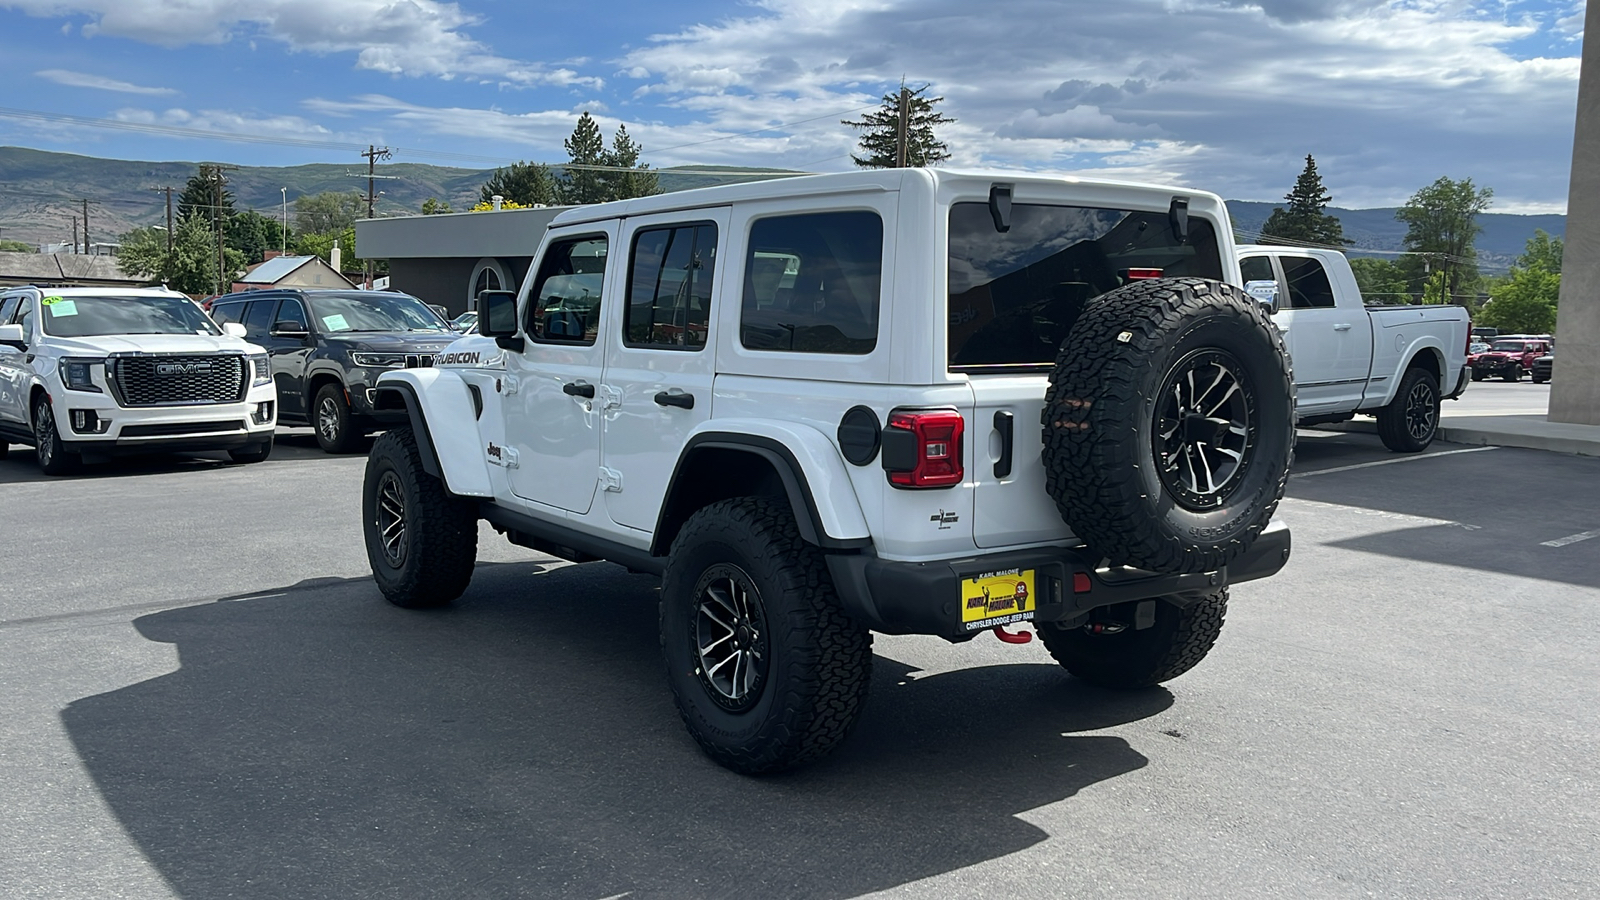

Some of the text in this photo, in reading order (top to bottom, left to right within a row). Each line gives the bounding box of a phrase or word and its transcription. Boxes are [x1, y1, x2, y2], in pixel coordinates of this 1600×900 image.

[434, 352, 480, 364] RUBICON
[156, 364, 212, 375] GMC
[487, 441, 501, 460] Jeep
[996, 568, 1019, 577] MALONE
[1017, 584, 1025, 594] 32
[967, 596, 984, 609] KARL
[966, 611, 1034, 630] CHRYSLER DODGE JEEP RAM
